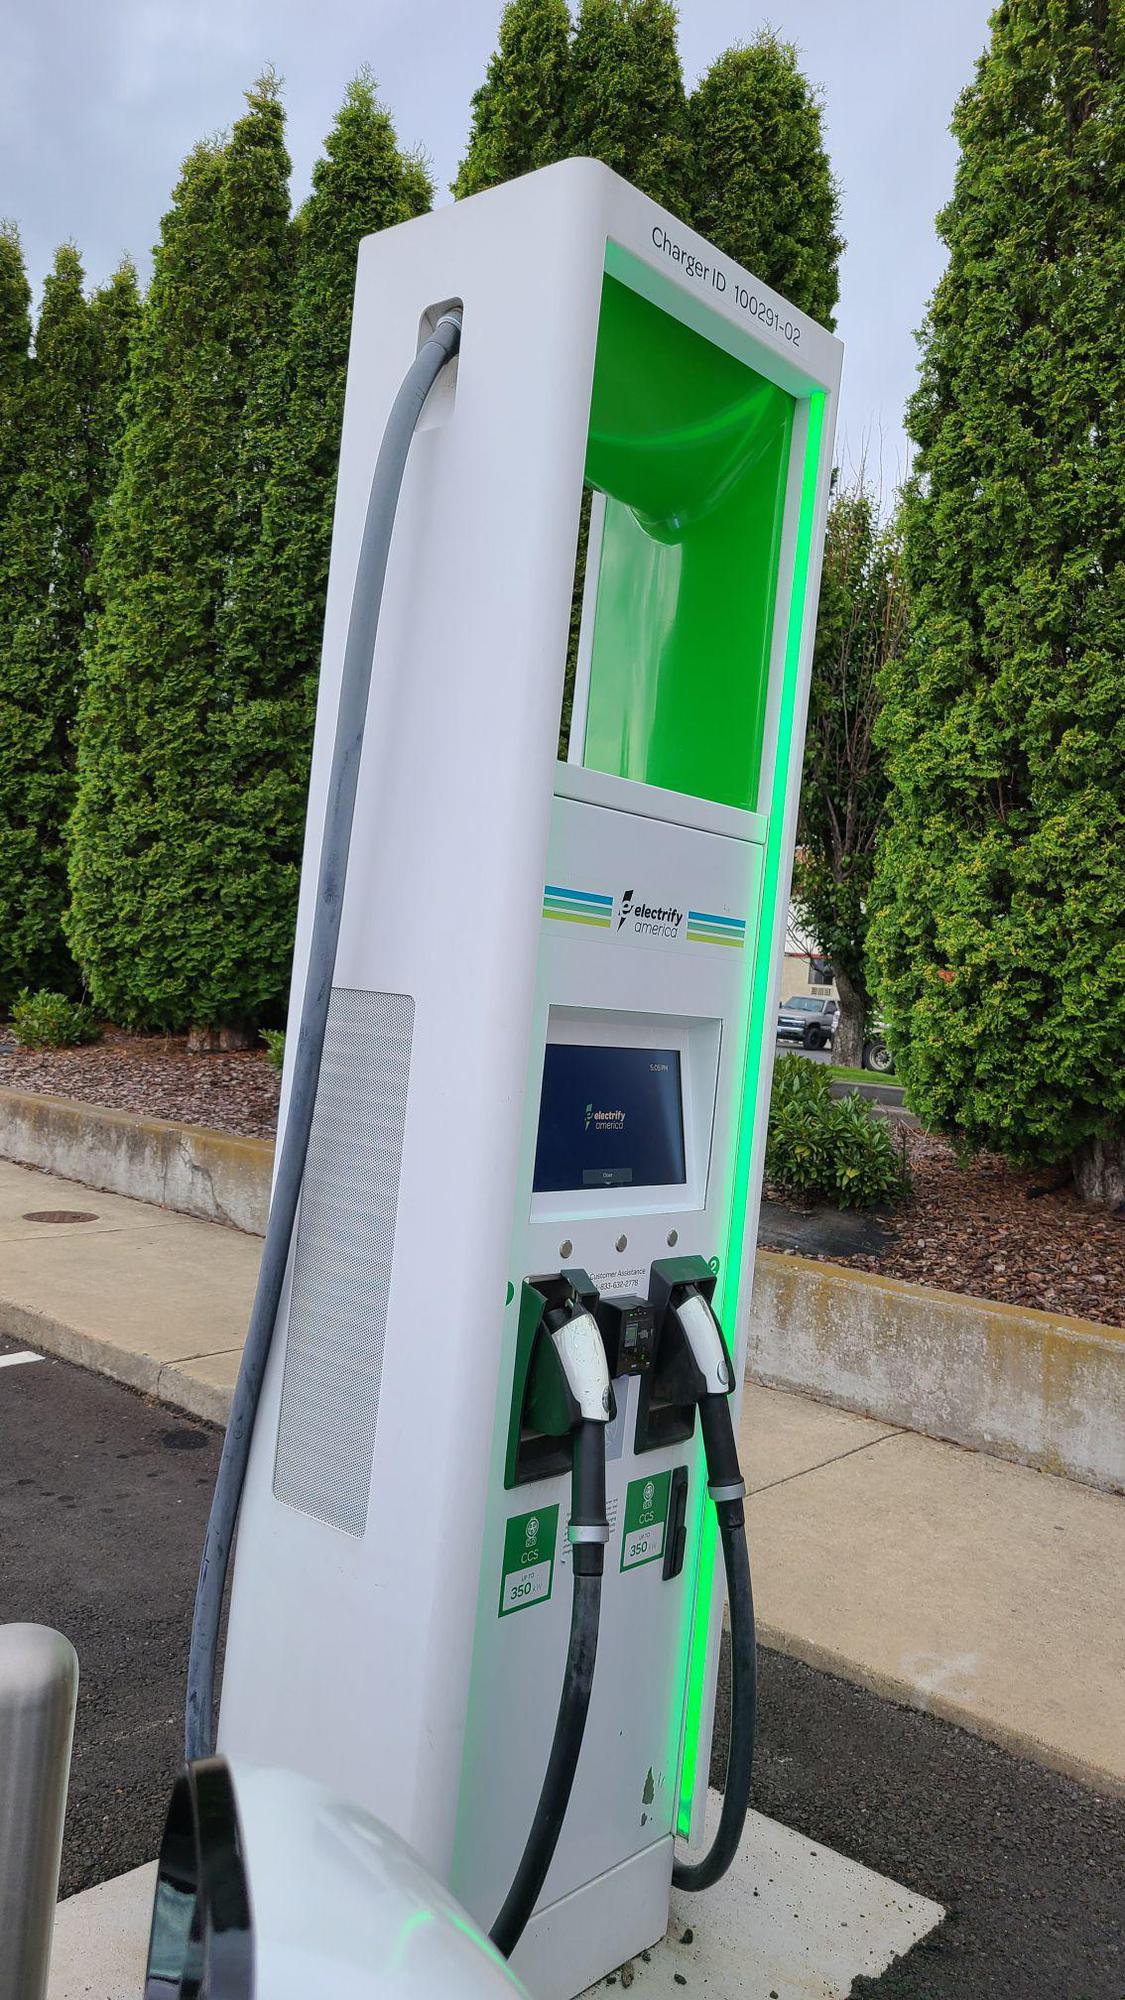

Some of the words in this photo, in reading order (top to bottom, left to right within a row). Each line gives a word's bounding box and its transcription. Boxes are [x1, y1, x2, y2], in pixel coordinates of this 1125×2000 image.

[652, 226, 709, 280] Charger
[712, 268, 726, 292] ID
[734, 285, 801, 347] 100291-02
[634, 903, 683, 927] electrify
[634, 921, 678, 938] america
[593, 1110, 626, 1122] electrify
[595, 1121, 624, 1130] america
[589, 1271, 617, 1280] Customer
[617, 1267, 646, 1277] Assistance
[710, 1260, 717, 1273] 2
[639, 1511, 654, 1525] CCS
[521, 1548, 539, 1564] CCS
[630, 1541, 648, 1557] 350
[510, 1582, 531, 1600] 350
